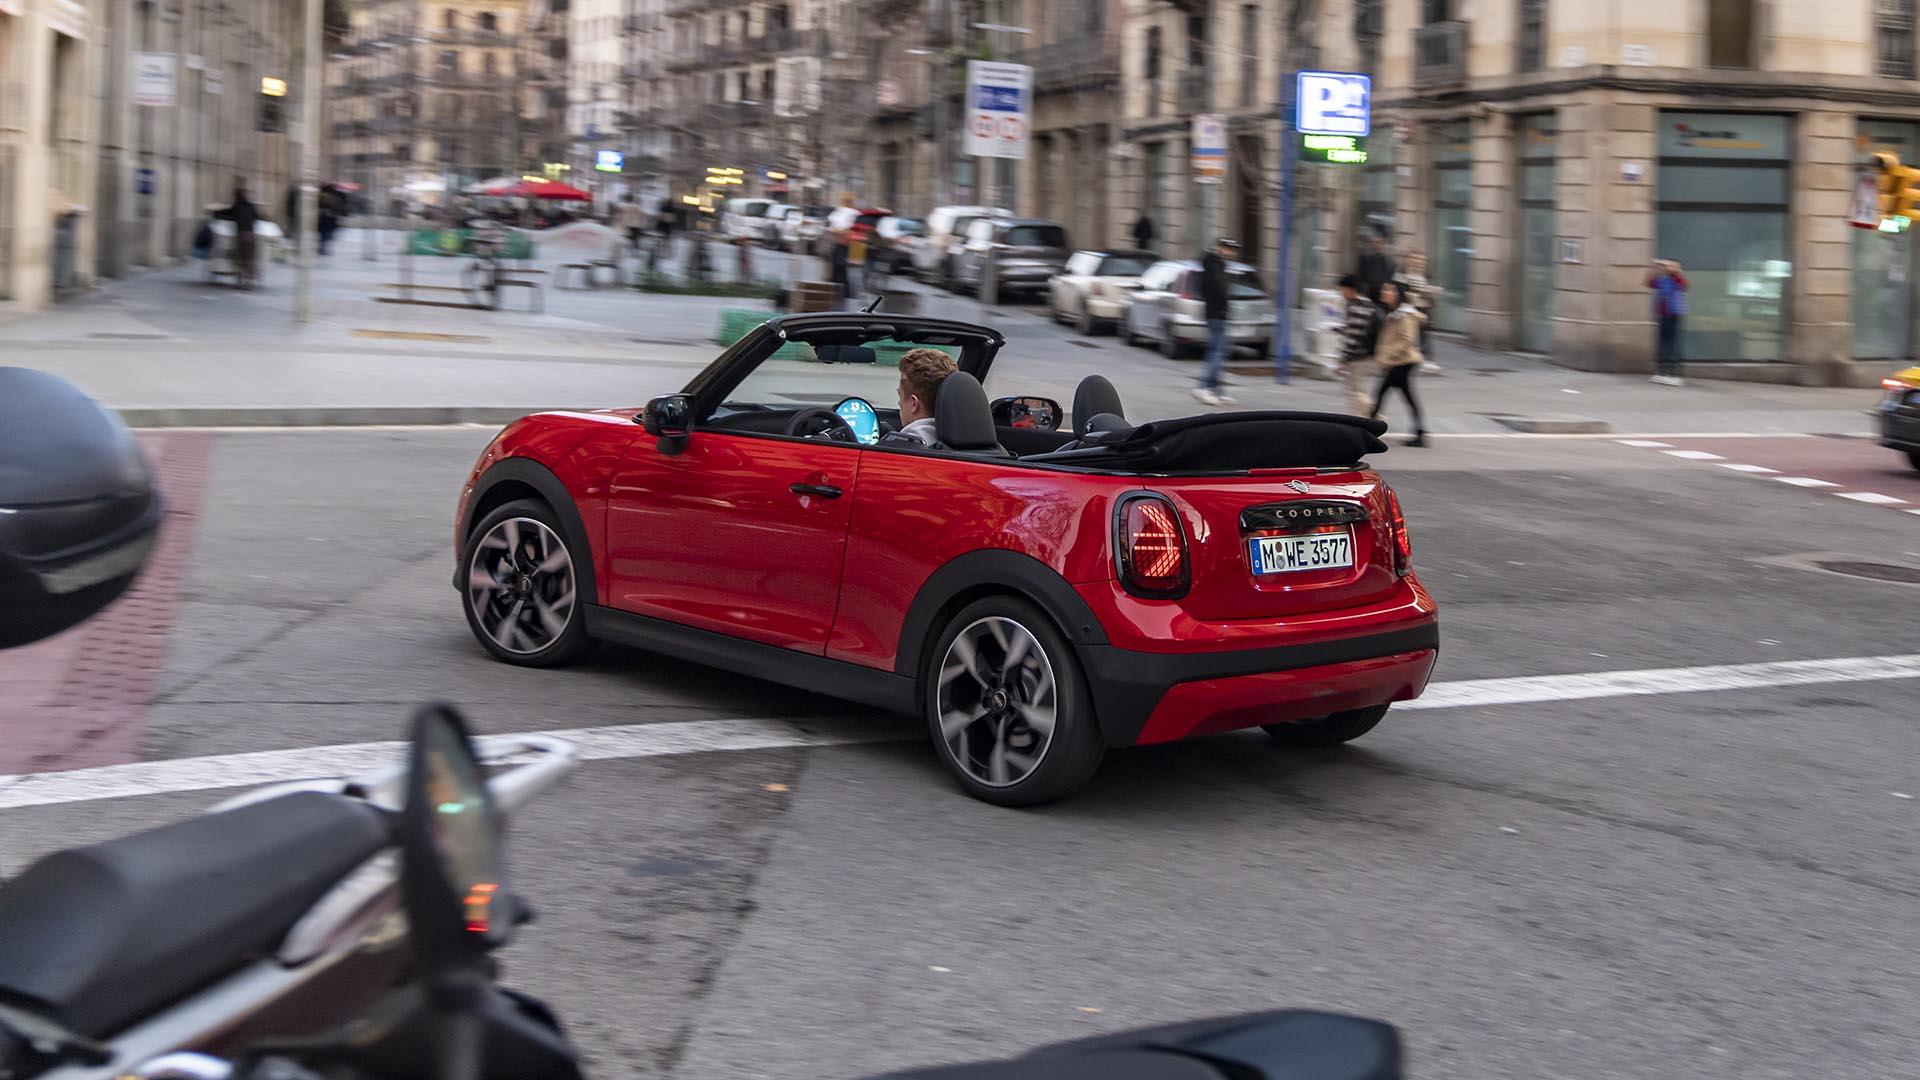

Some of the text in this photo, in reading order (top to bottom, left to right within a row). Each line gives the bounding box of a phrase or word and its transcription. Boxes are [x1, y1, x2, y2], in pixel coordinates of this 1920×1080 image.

[1276, 507, 1346, 518] COOPER
[1262, 538, 1348, 569] M WE 3577
